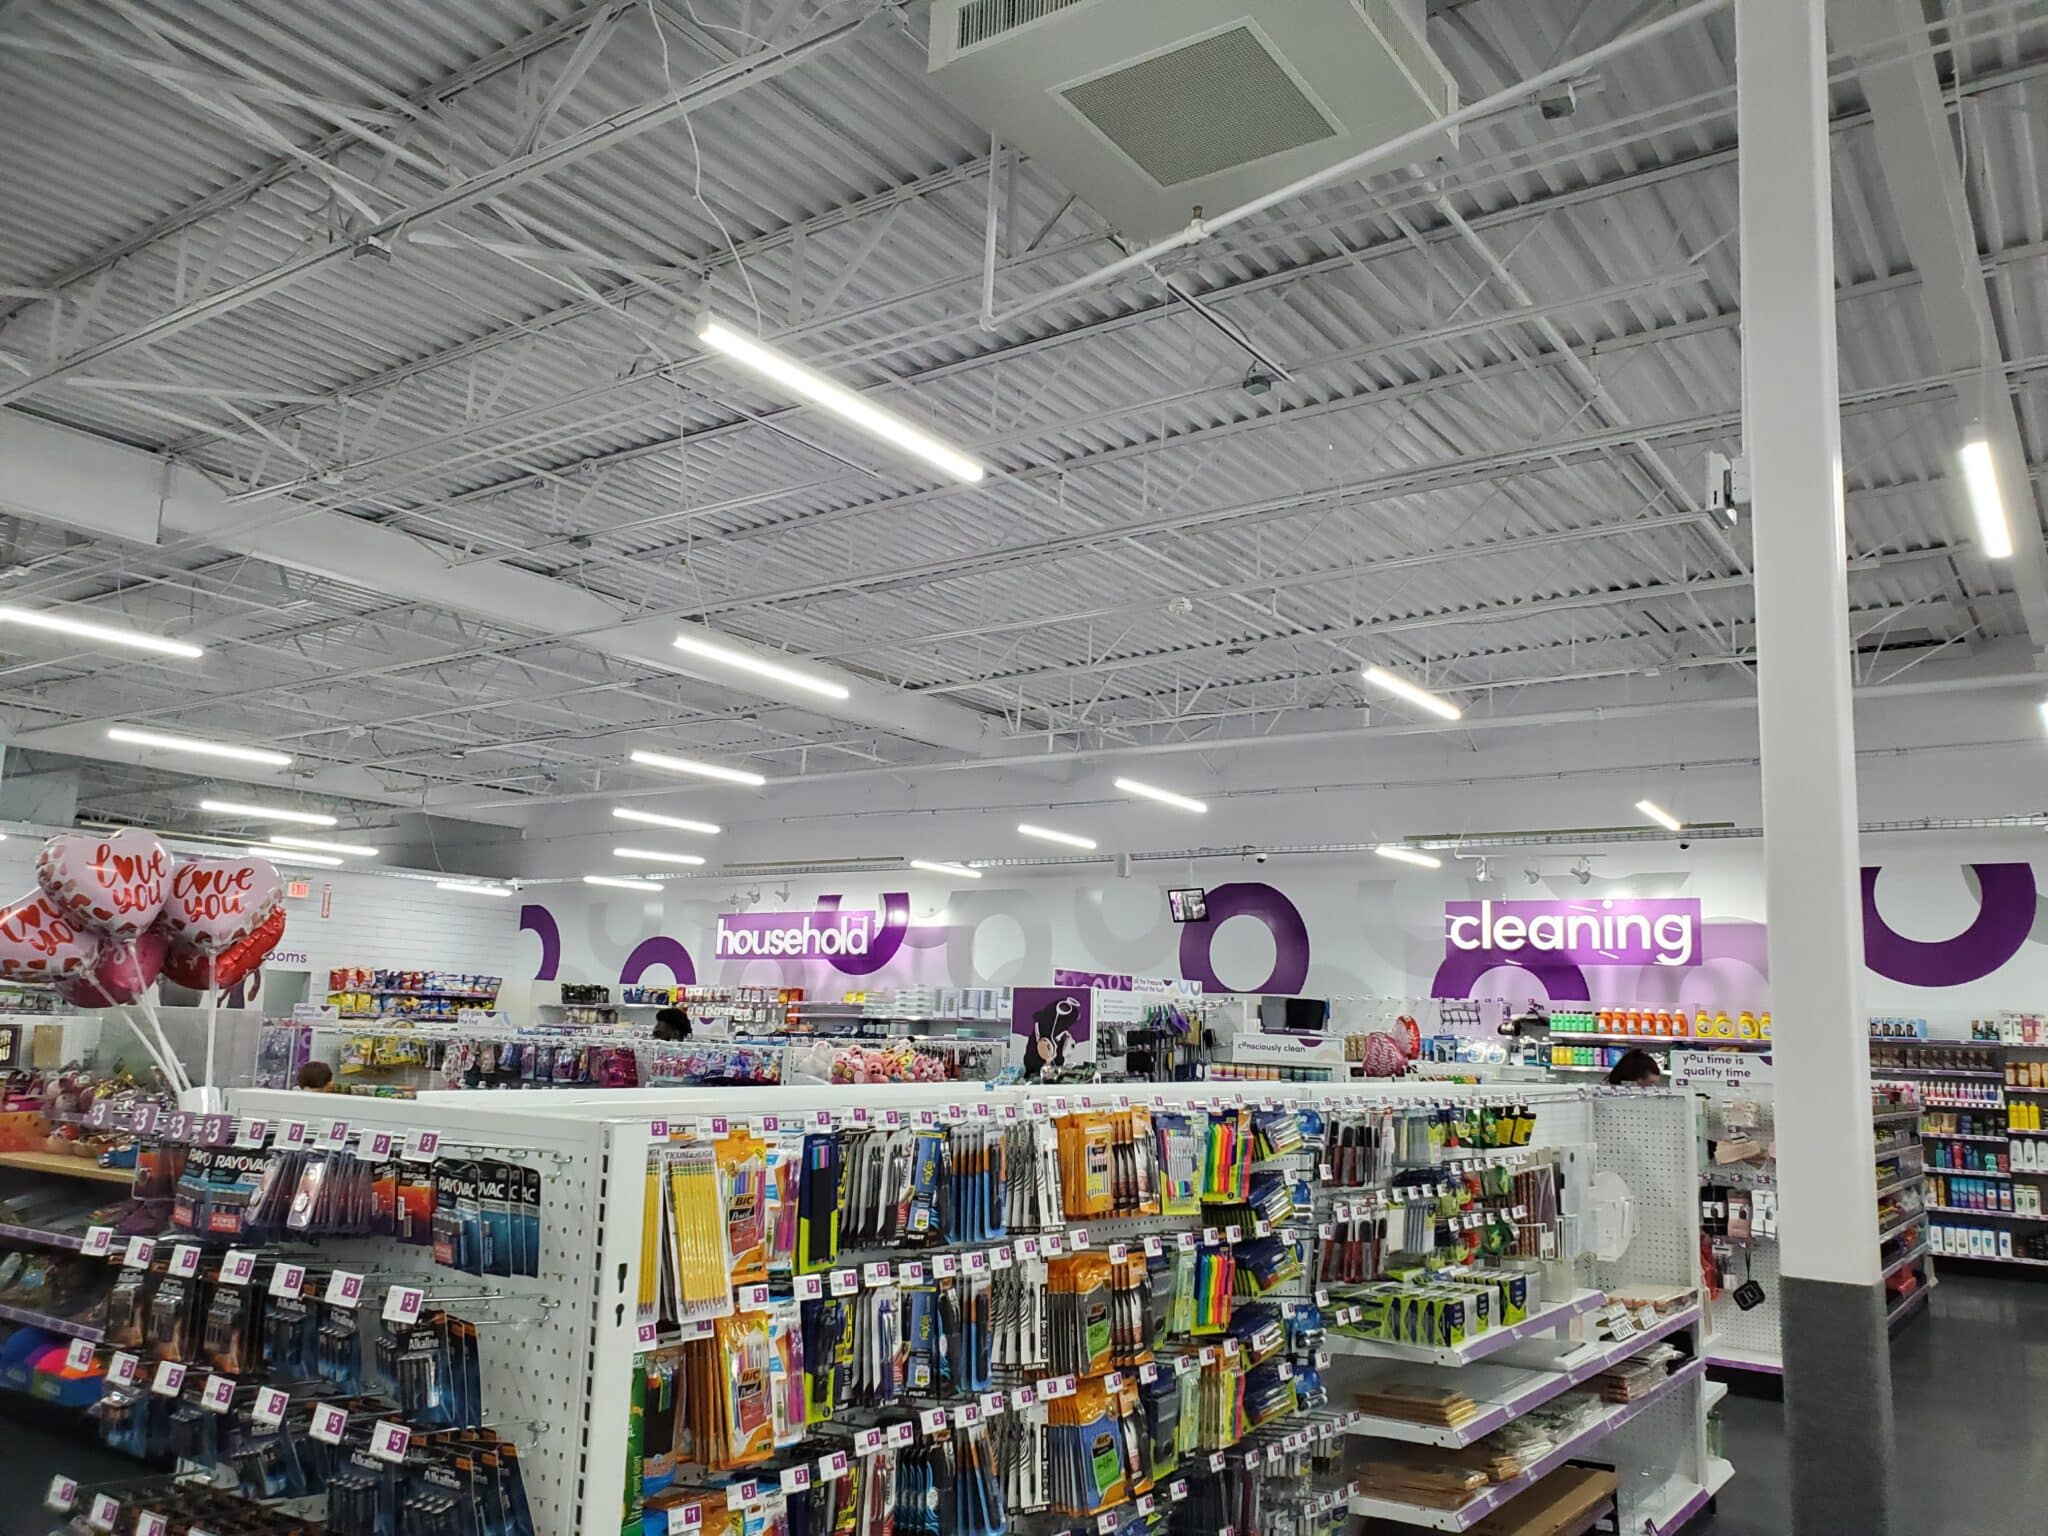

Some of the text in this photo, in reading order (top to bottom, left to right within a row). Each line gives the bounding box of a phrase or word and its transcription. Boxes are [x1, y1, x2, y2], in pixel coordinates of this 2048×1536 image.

[112, 879, 162, 914] you
[184, 891, 245, 923] you
[715, 917, 868, 957] household
[1450, 899, 1692, 966] cleaning
[1283, 1043, 1306, 1053] clean
[1683, 1053, 1745, 1068] you time is
[1683, 1066, 1751, 1079] quality time
[134, 1107, 149, 1131] $3
[170, 1114, 185, 1138] $3
[714, 1120, 724, 1132] $1
[204, 1118, 220, 1143] $3
[253, 1124, 262, 1138] $2
[291, 1124, 301, 1140] $2
[334, 1123, 344, 1138] $2
[653, 1122, 663, 1134] $3
[376, 1136, 387, 1152] $2
[422, 1135, 432, 1150] $3
[215, 1151, 274, 1173] RAYOVAC
[438, 1175, 477, 1199] RAYOVAC
[405, 1294, 416, 1310] $3
[641, 1326, 650, 1340] $3
[407, 1335, 440, 1351] Alkaline
[271, 1394, 283, 1413] $5
[330, 1414, 340, 1432] $5
[391, 1432, 402, 1451] $5
[350, 1452, 384, 1472] Alkaline
[423, 1469, 461, 1490] Alkaline
[687, 1508, 697, 1521] $1
